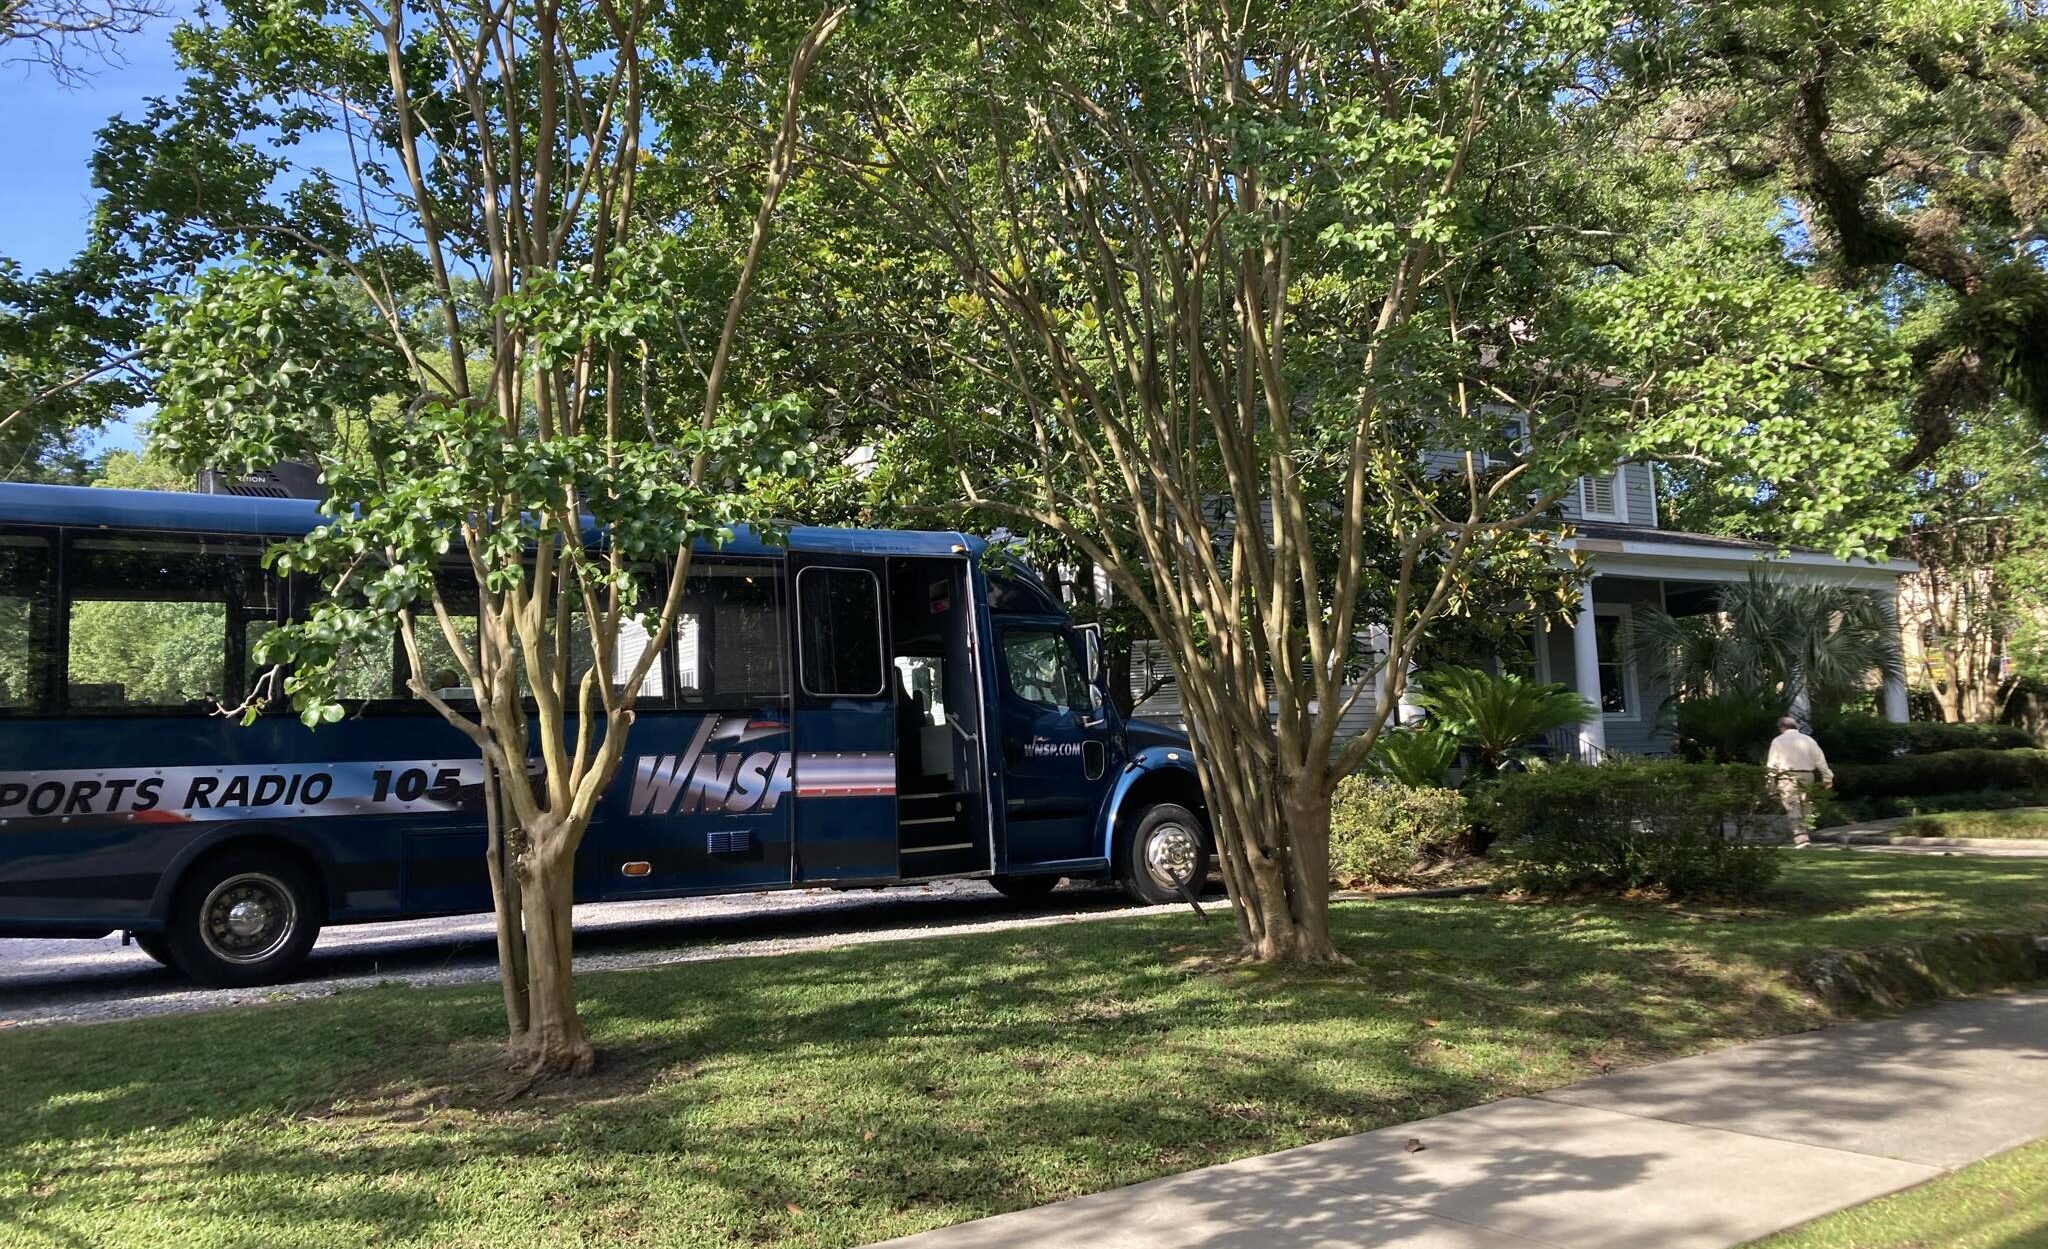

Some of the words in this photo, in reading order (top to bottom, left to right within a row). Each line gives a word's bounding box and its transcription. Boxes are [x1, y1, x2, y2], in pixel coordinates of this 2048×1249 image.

[1024, 735, 1081, 757] WNSP.COM
[0, 777, 165, 816] PORTS
[182, 772, 333, 810] RADIO
